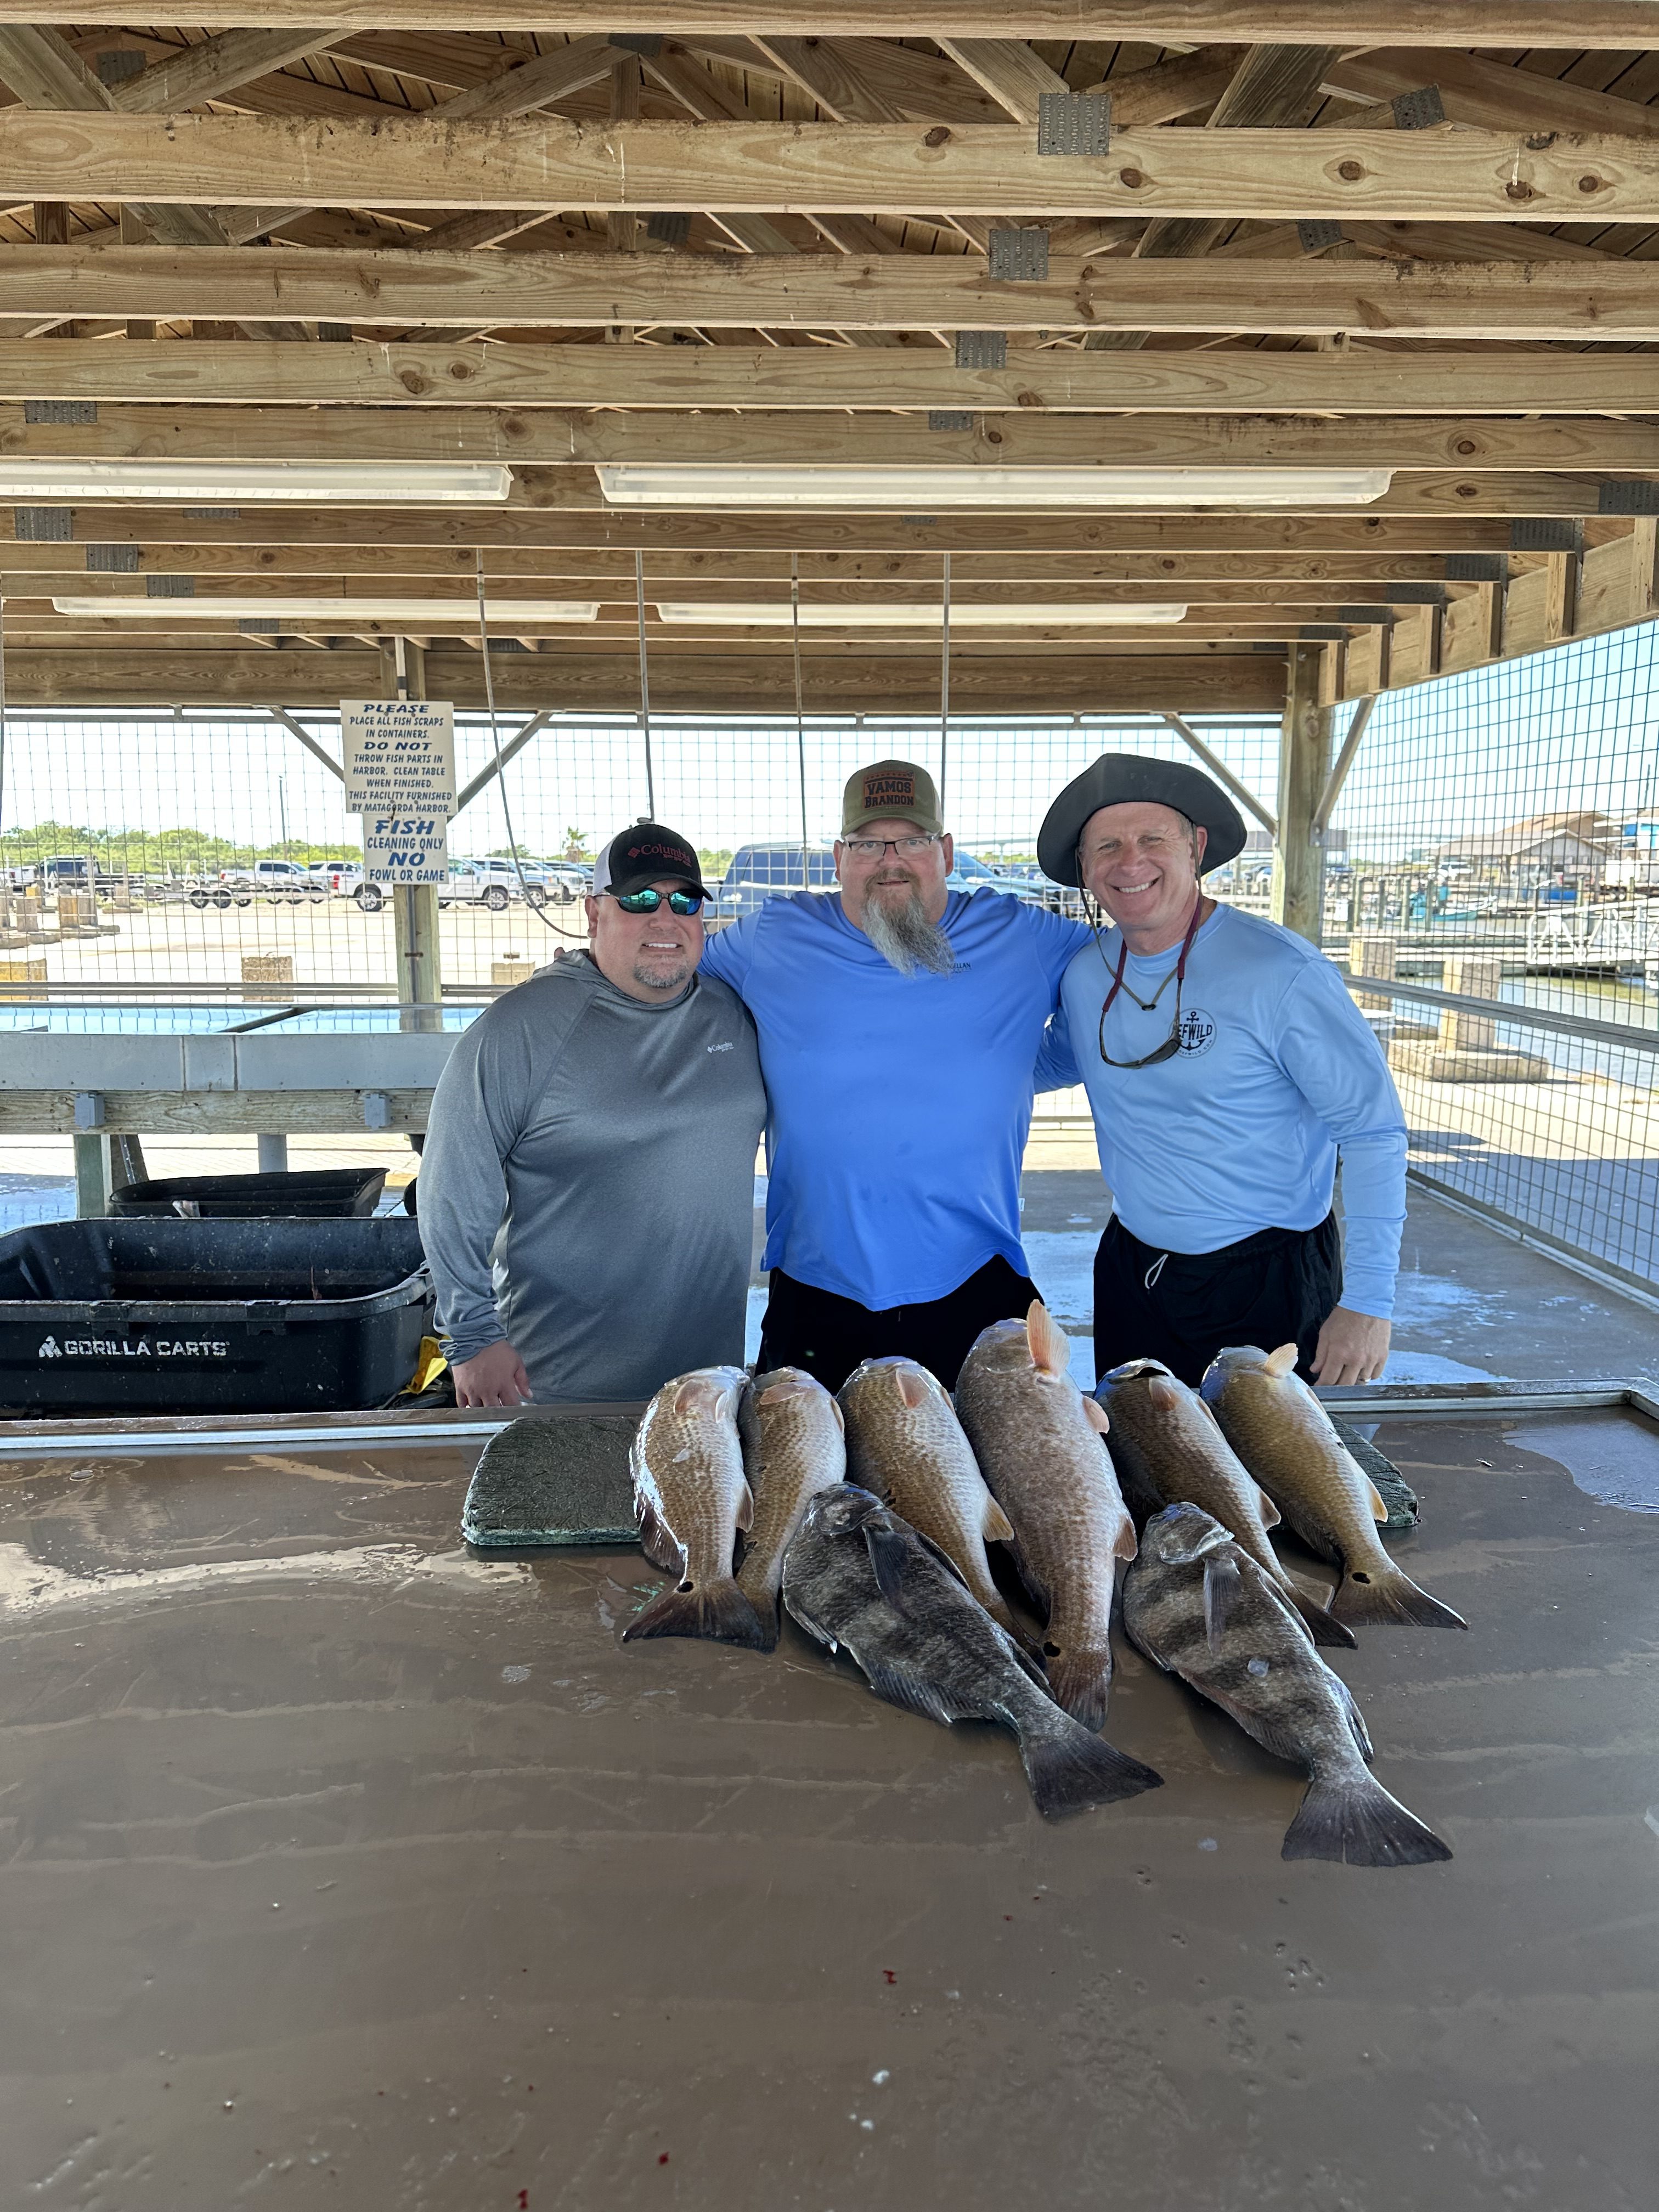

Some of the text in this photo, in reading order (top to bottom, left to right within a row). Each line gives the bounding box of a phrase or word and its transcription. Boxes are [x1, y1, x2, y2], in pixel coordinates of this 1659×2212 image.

[364, 704, 430, 713] PLEASE
[350, 716, 444, 726] PLACE ALL FISH SCRAPS
[366, 729, 430, 738] IN CONTAINERS.
[364, 742, 432, 751] DO NOT
[354, 754, 443, 764] THROW FISH PARTS IN
[353, 766, 445, 776] HARBOR. CLEAN TABLE
[367, 779, 434, 788] WHEN FINISHED.
[867, 781, 911, 795] VAMOS
[349, 791, 452, 800] THIS FACILITY FURNISHED
[865, 795, 913, 808] BRANDON
[352, 803, 451, 812] BY MATAGORDA HARBOR.
[375, 820, 435, 834] FISH
[367, 837, 444, 850] CLEANING ONLY
[388, 852, 425, 866] NO
[641, 844, 691, 864] Columbia
[370, 869, 445, 882] FOWL OR GAME
[64, 1340, 151, 1356] GORILLA
